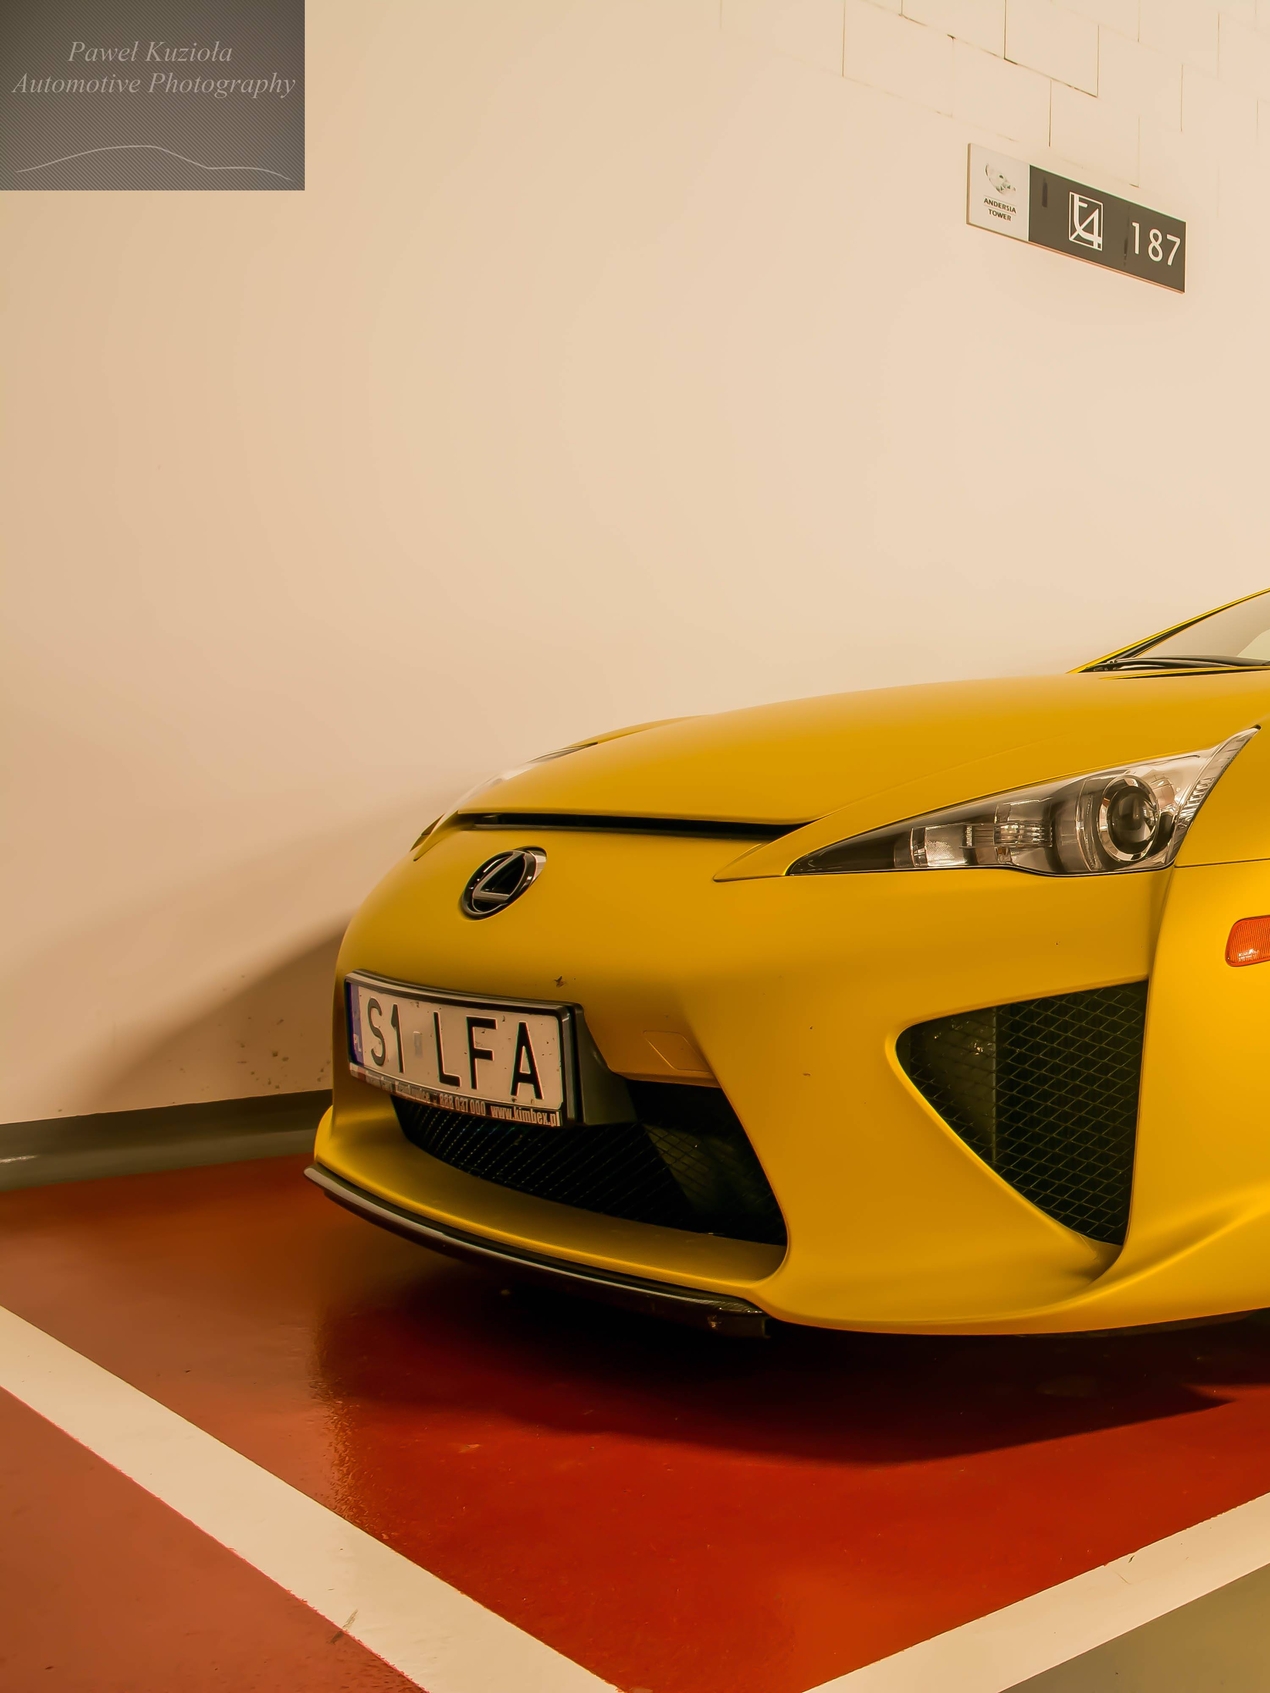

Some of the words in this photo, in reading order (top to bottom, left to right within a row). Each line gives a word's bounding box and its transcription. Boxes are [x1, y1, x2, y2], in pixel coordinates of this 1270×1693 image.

[984, 198, 1016, 213] ANDERSIA
[988, 208, 1011, 221] TOWER
[1131, 221, 1181, 266] 187
[367, 996, 405, 1074] S1
[433, 1011, 545, 1100] LFA
[490, 1105, 560, 1127] www.kimbex.pl
